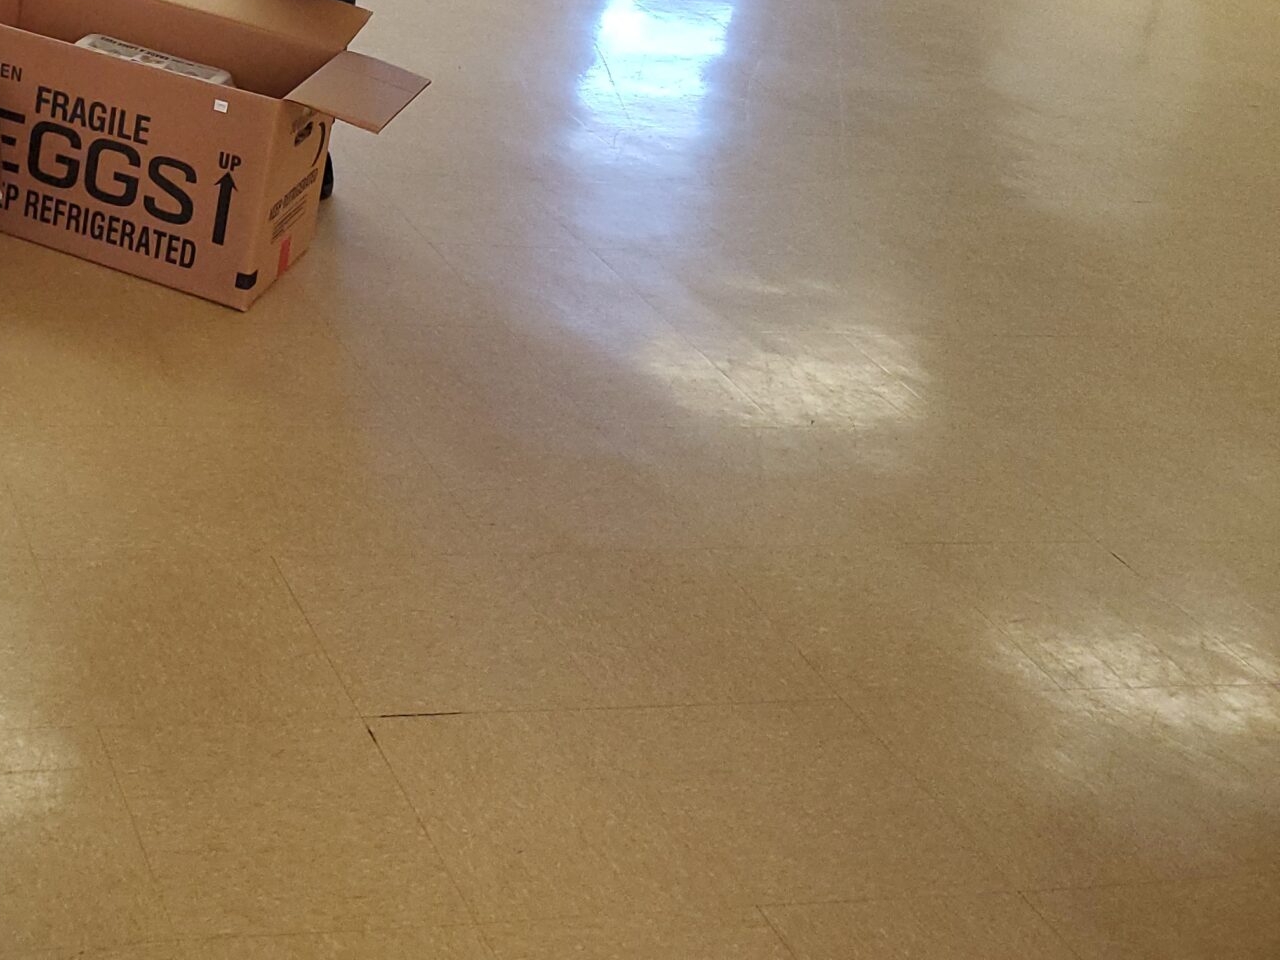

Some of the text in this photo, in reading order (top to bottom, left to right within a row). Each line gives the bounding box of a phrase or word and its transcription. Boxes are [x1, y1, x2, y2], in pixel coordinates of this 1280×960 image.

[35, 86, 151, 145] FRAGILE
[219, 151, 241, 171] UP
[24, 189, 197, 269] REFRIGERATED
